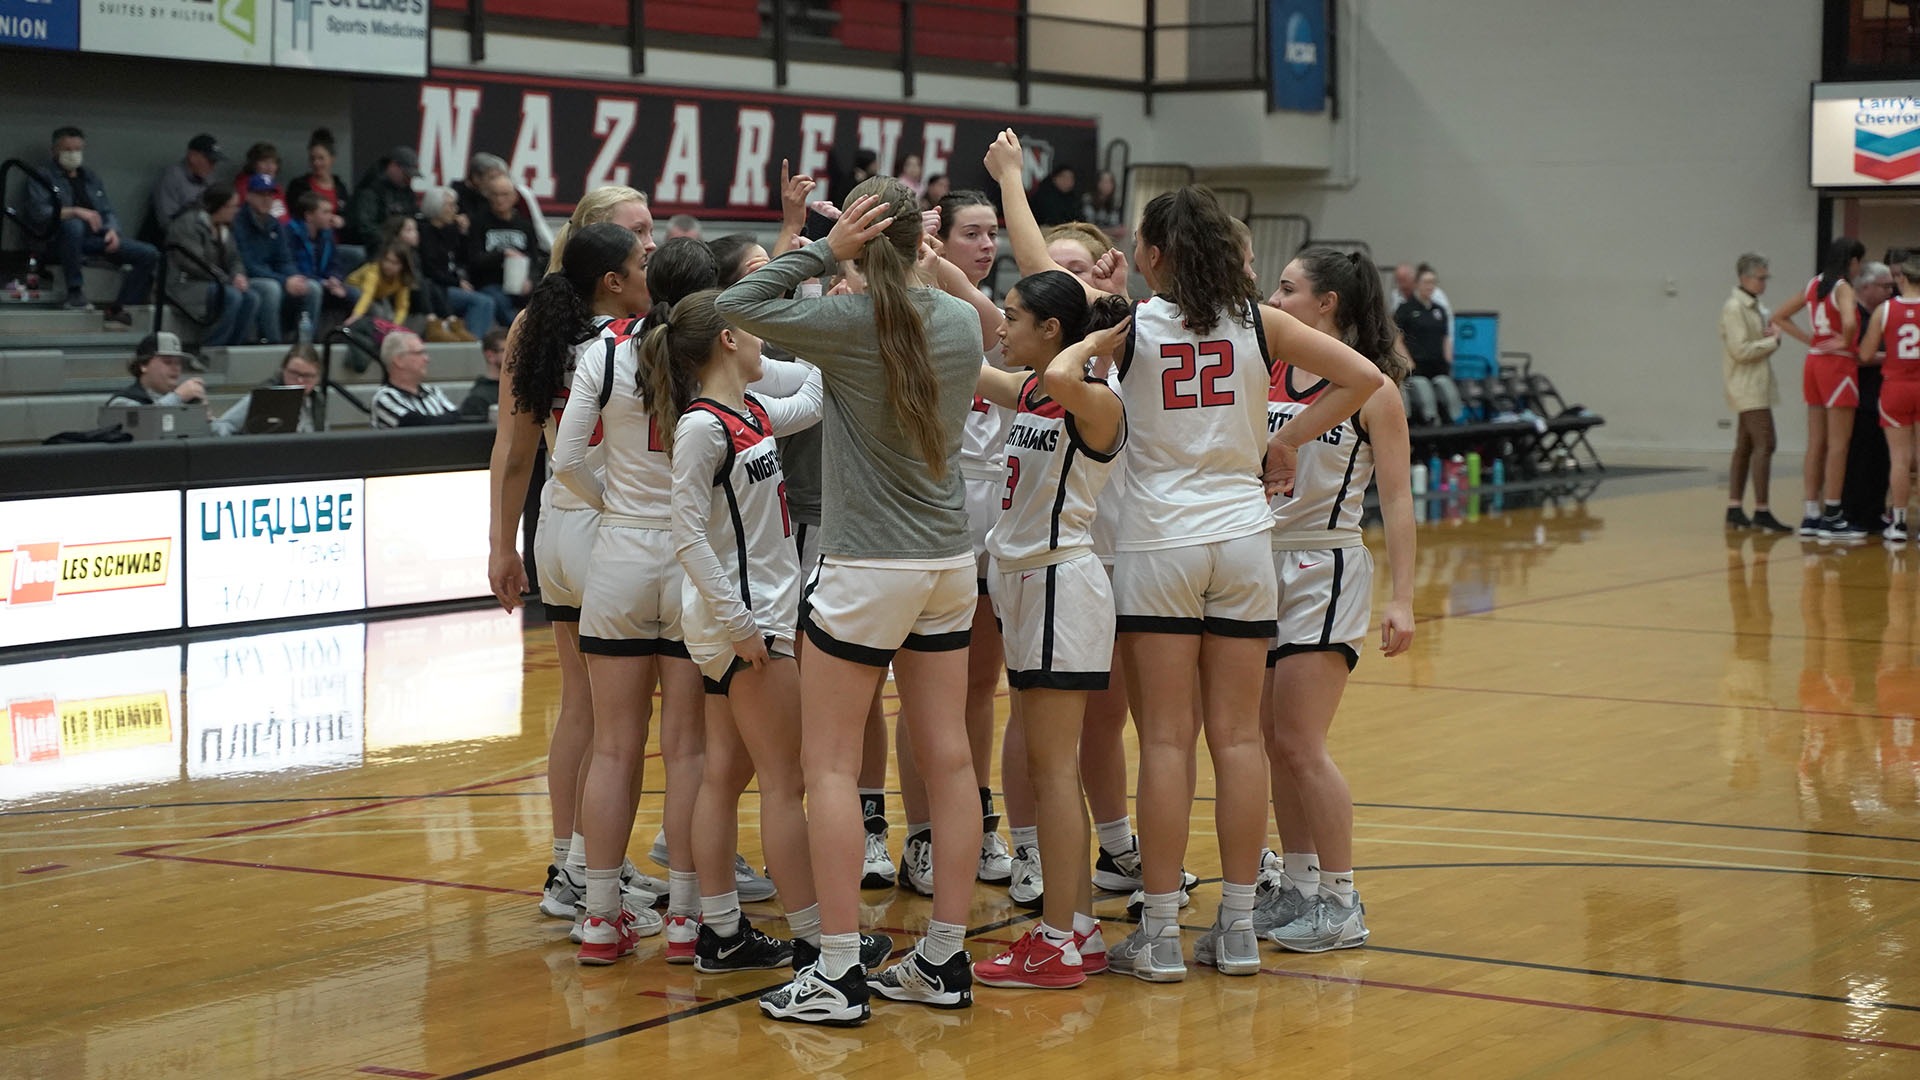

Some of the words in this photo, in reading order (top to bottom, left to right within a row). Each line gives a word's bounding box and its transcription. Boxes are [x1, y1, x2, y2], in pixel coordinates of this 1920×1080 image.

[98, 3, 145, 17] SUITES
[327, 15, 368, 34] Sports
[371, 20, 427, 39] Medicine
[410, 84, 957, 206] NAZARENE
[1160, 339, 1234, 410] 22
[1001, 455, 1020, 510] 3
[201, 493, 353, 544] UNIGLOBE
[62, 557, 89, 581] LES
[93, 551, 162, 578] SCHWAB
